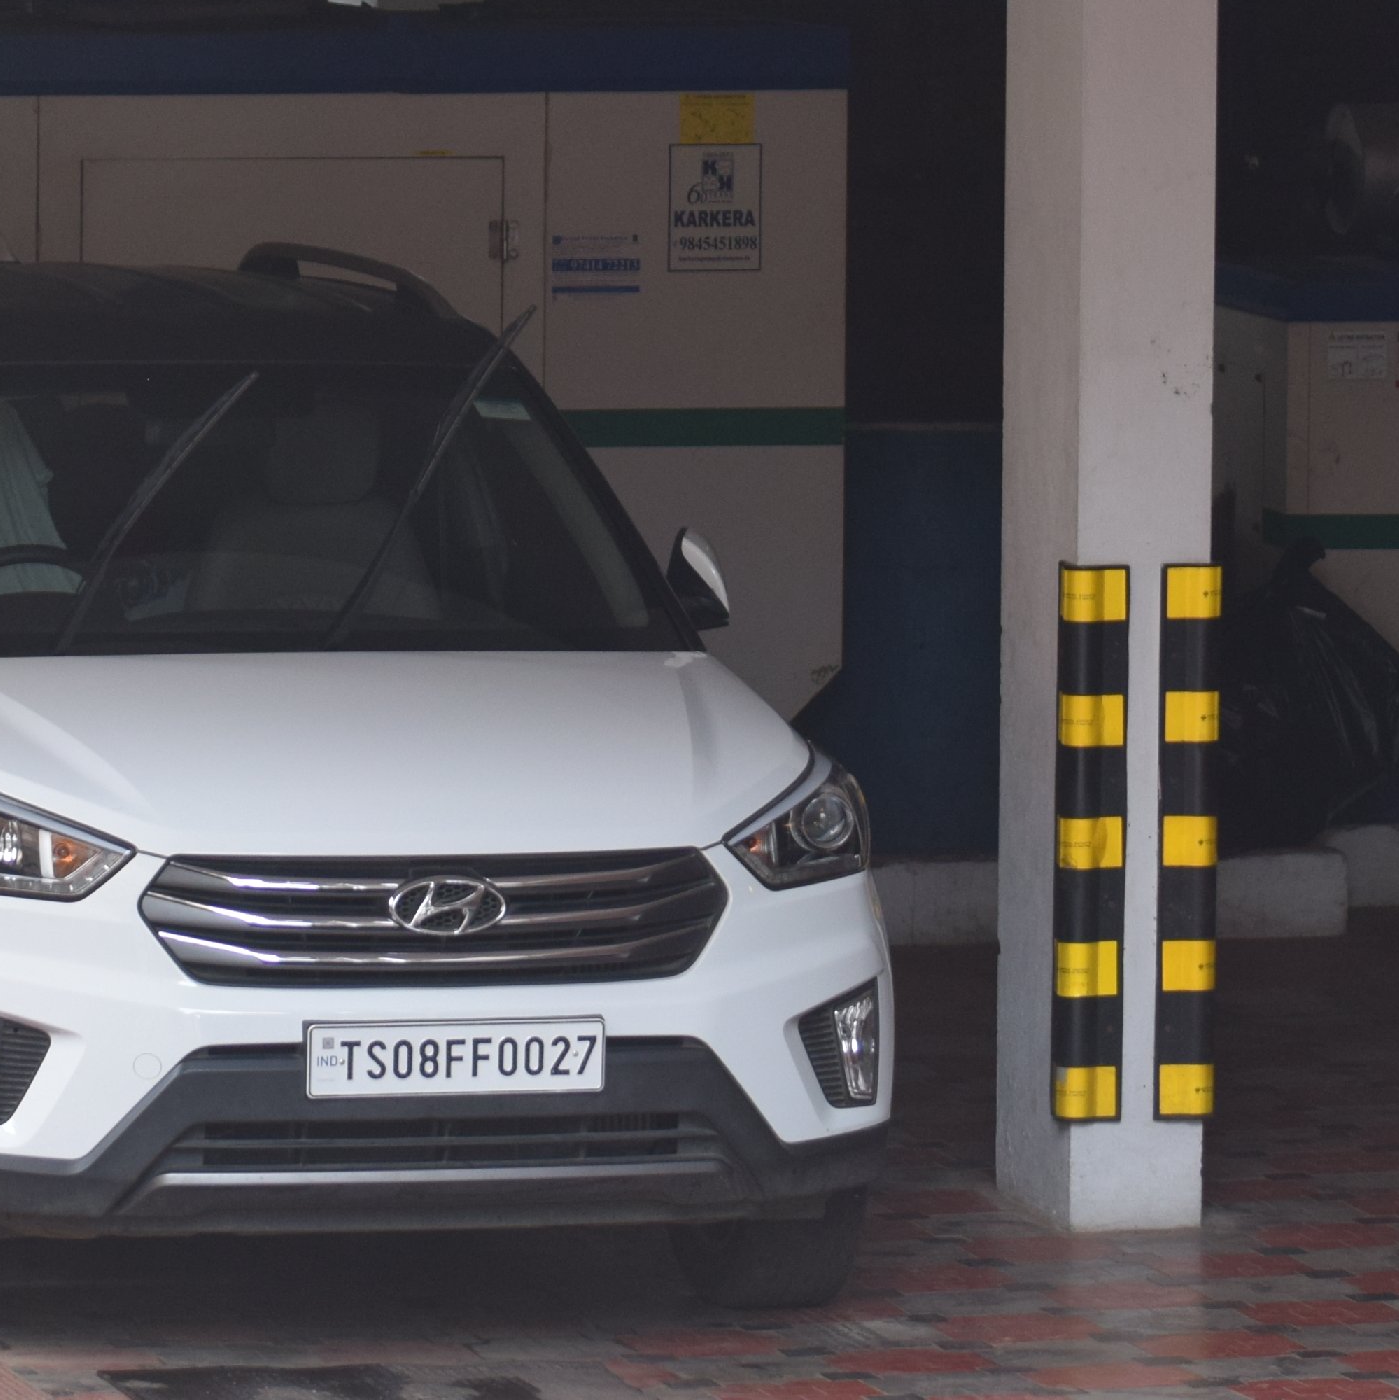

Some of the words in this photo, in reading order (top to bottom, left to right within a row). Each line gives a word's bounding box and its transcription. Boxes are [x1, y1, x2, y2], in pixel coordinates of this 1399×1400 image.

[673, 209, 756, 228] KARKERA
[679, 235, 758, 251] 9845451898
[315, 1055, 339, 1067] IND
[340, 1035, 598, 1081] TS08FF0027
